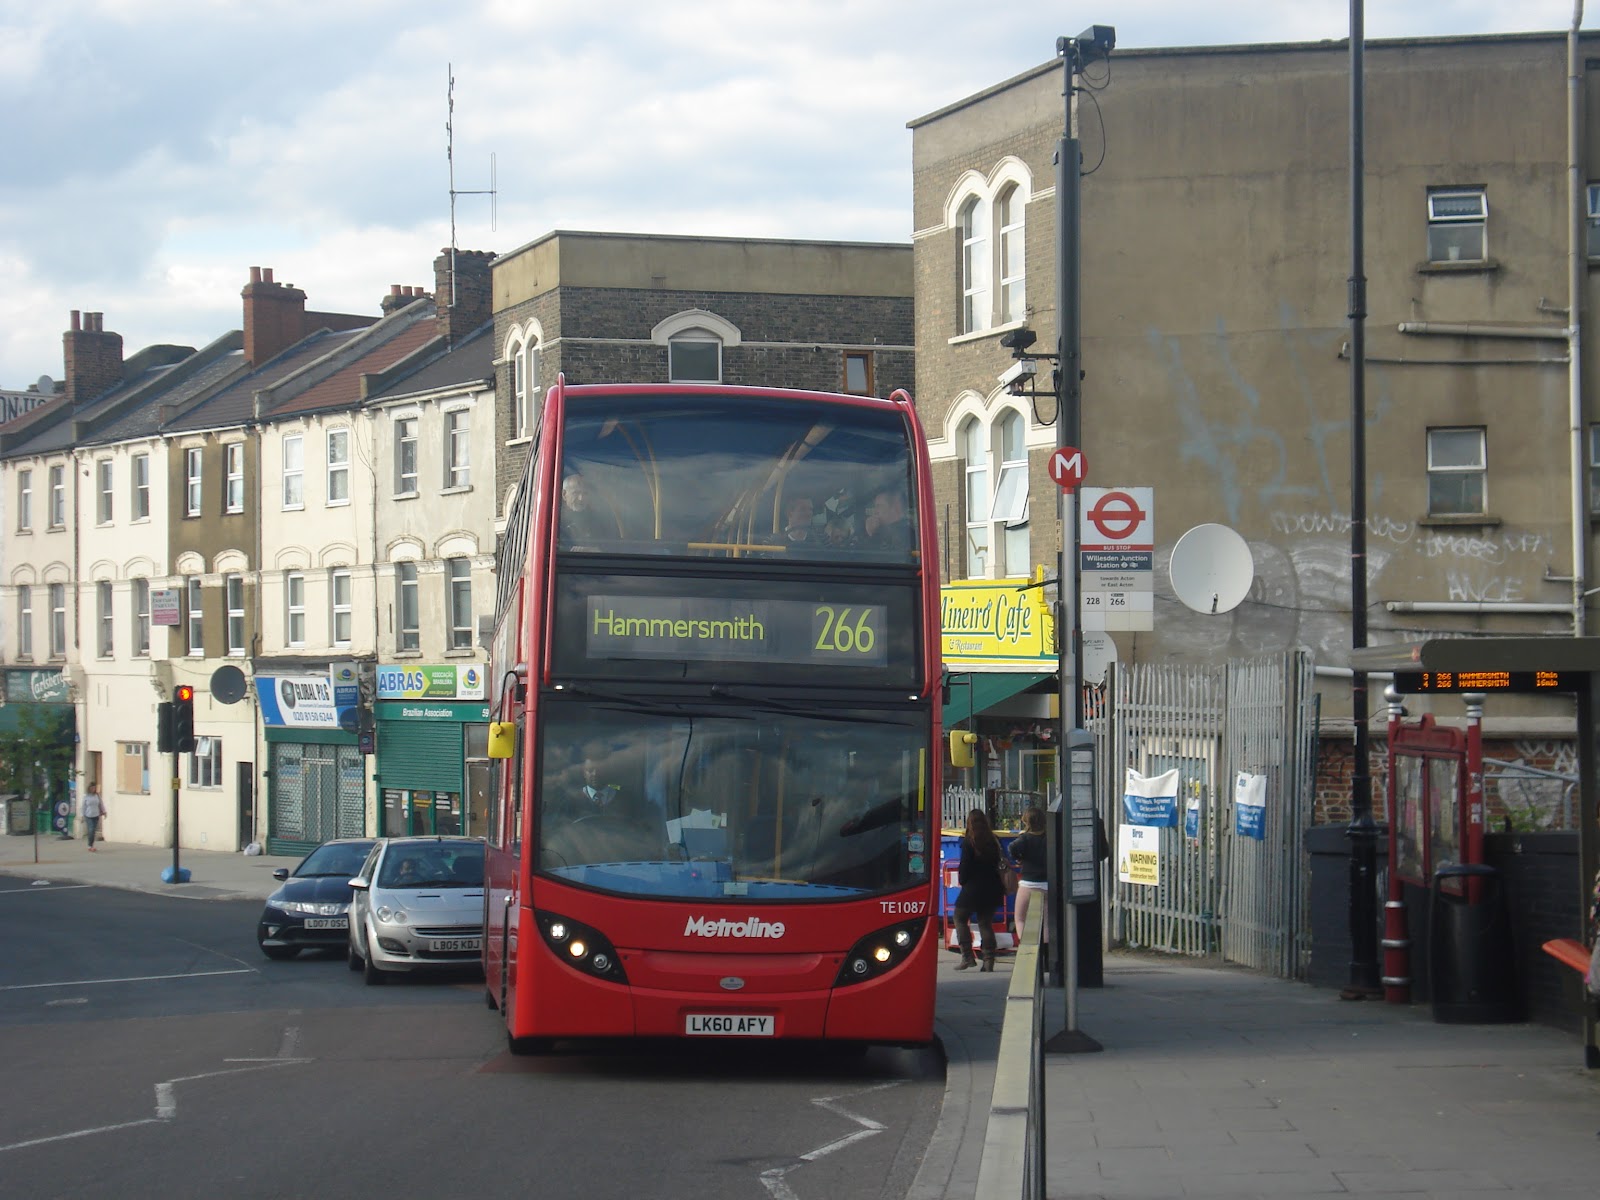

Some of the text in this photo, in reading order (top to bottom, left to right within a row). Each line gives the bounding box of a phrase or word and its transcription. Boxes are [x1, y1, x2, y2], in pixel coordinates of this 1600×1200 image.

[1055, 452, 1082, 479] M
[1086, 597, 1100, 605] 228
[1110, 598, 1126, 606] 266
[594, 609, 764, 640] Hammersmith
[941, 593, 1031, 644] ineiro Cafe
[815, 606, 875, 652] 266
[378, 671, 423, 692] ABRAS
[1436, 680, 1452, 688] 266
[1458, 679, 1510, 687] HAMMERSMITH
[1458, 672, 1510, 680] HAMMERSMITH
[31, 671, 66, 701] Carlsberg
[294, 683, 318, 701] GLOBAL
[293, 711, 304, 721] 020
[402, 708, 453, 717] Brazilian Association
[1129, 853, 1157, 866] WARNING
[880, 901, 926, 914] TE1087
[684, 915, 786, 939] Metroline
[692, 1017, 767, 1032] LK60 AFY
